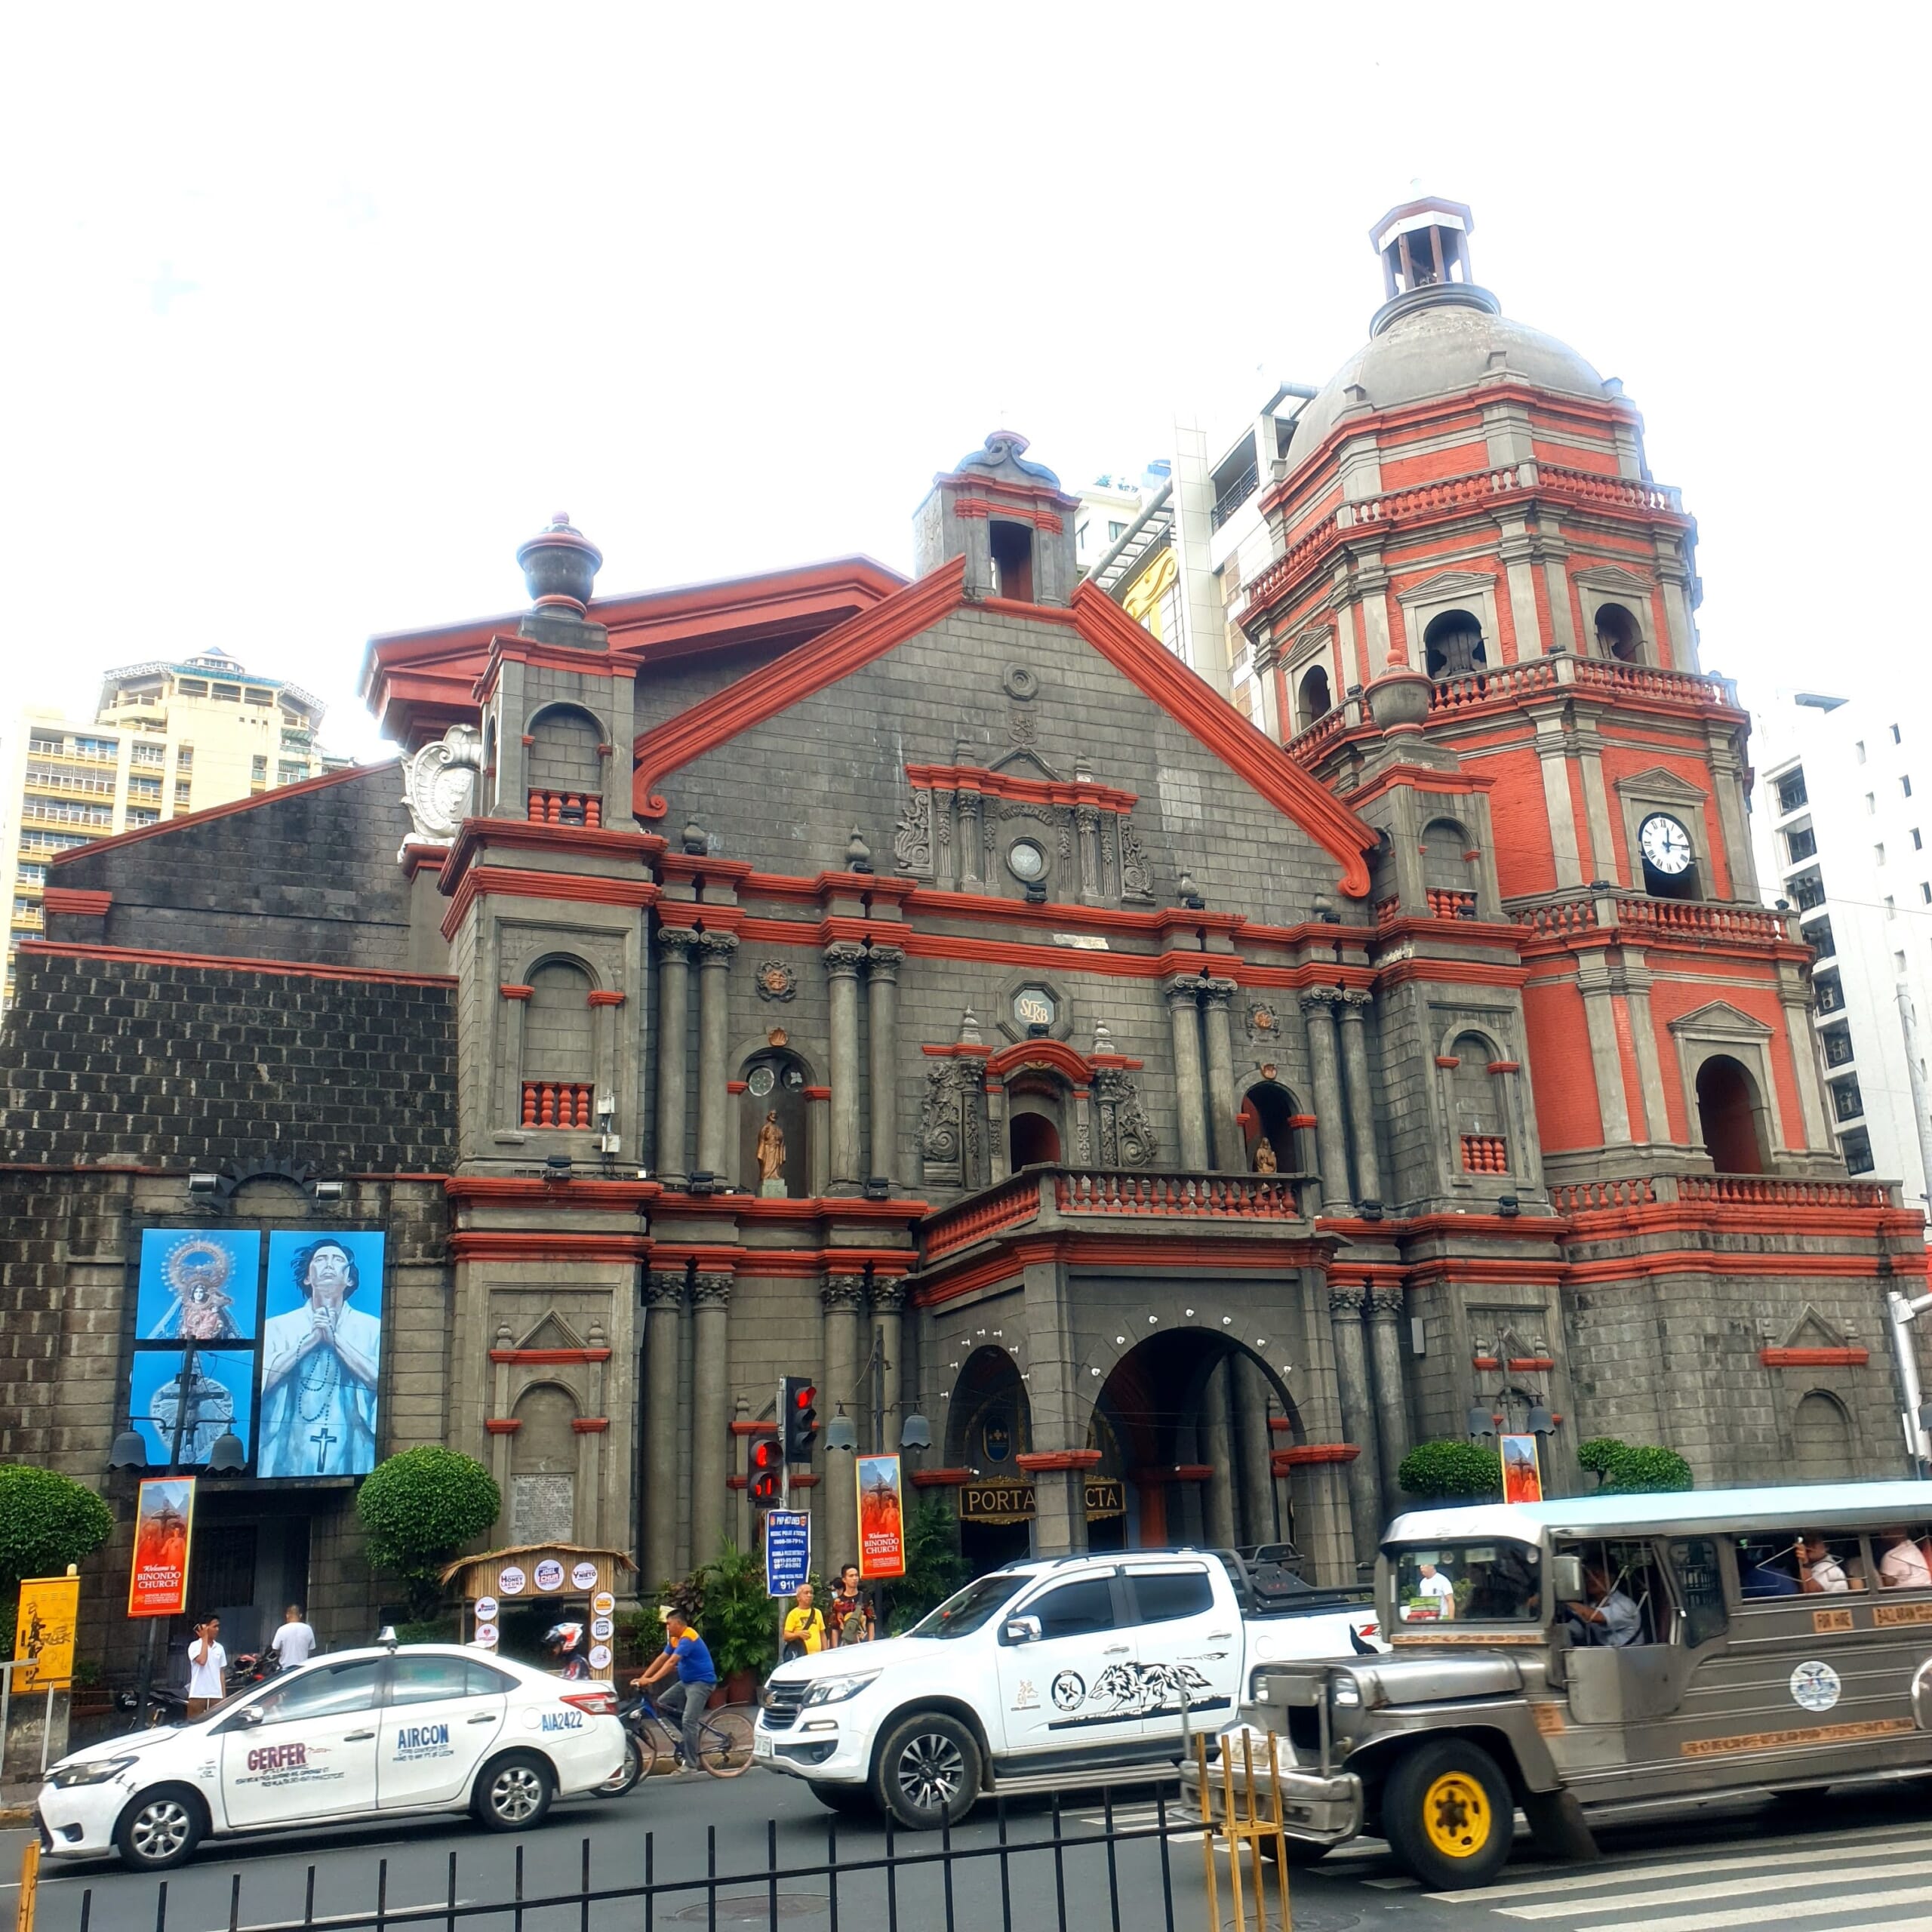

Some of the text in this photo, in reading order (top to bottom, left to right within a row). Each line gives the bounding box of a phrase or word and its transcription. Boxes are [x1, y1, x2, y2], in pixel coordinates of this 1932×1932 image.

[968, 1487, 1118, 1512] PORTA CTA
[864, 1537, 900, 1547] BINONDO
[866, 1545, 898, 1555] CHURCH
[137, 1571, 182, 1581] BINONDO
[138, 1579, 179, 1589] CHURCH
[780, 1580, 795, 1590] 911
[398, 1724, 449, 1749] AIRCON
[248, 1742, 306, 1771] GERFER
